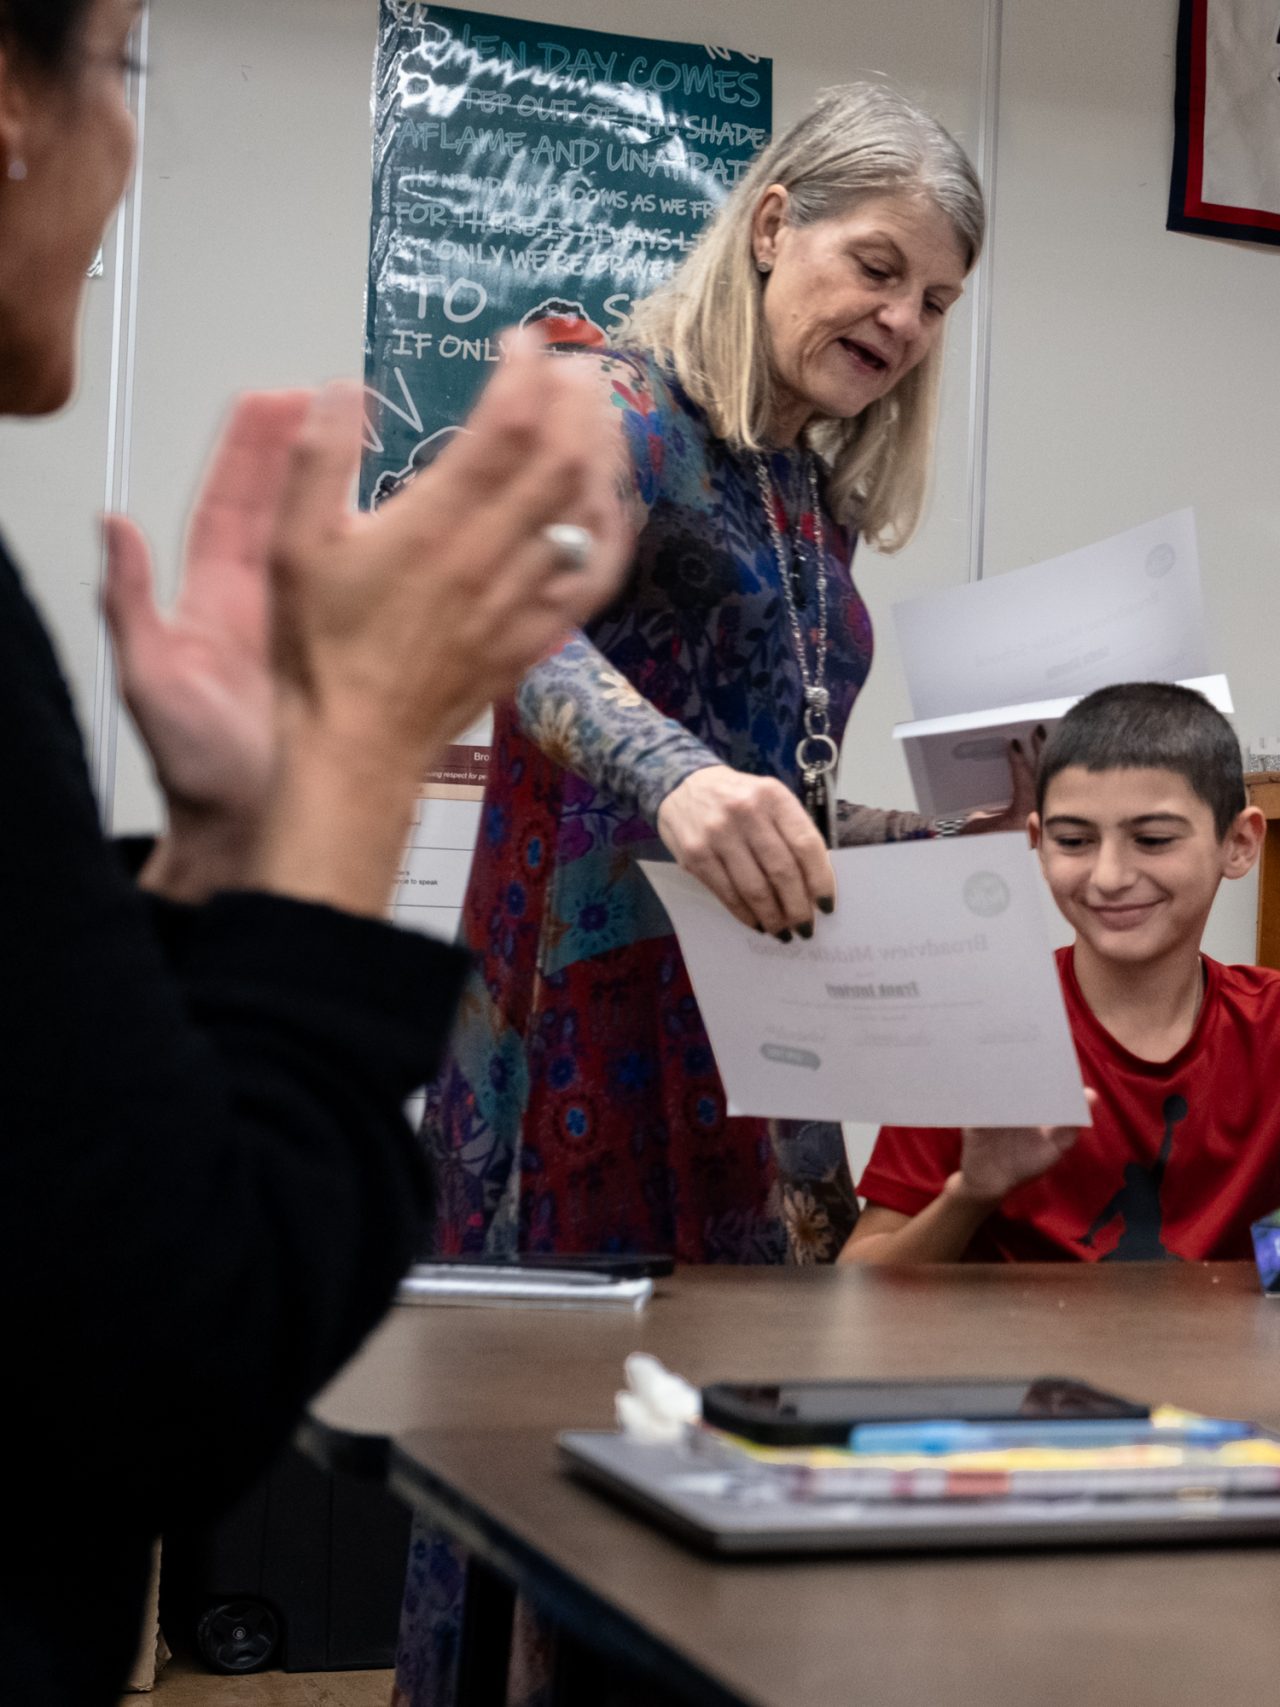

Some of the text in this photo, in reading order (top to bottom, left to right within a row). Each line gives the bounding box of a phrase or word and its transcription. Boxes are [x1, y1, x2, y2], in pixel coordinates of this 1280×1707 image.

[537, 42, 617, 86] DAY
[628, 56, 761, 108] COMES
[515, 94, 577, 121] OUT
[581, 102, 619, 126] OF
[686, 114, 766, 150] SHADE
[395, 118, 527, 158] AFLAME
[532, 135, 600, 168] AND
[392, 202, 447, 227] FOR
[541, 217, 574, 241] IS
[631, 194, 657, 212] AS
[660, 198, 687, 216] WE
[435, 239, 506, 268] ONLY
[388, 272, 488, 323] TO
[392, 328, 433, 359] IF
[473, 752, 490, 762] Bro
